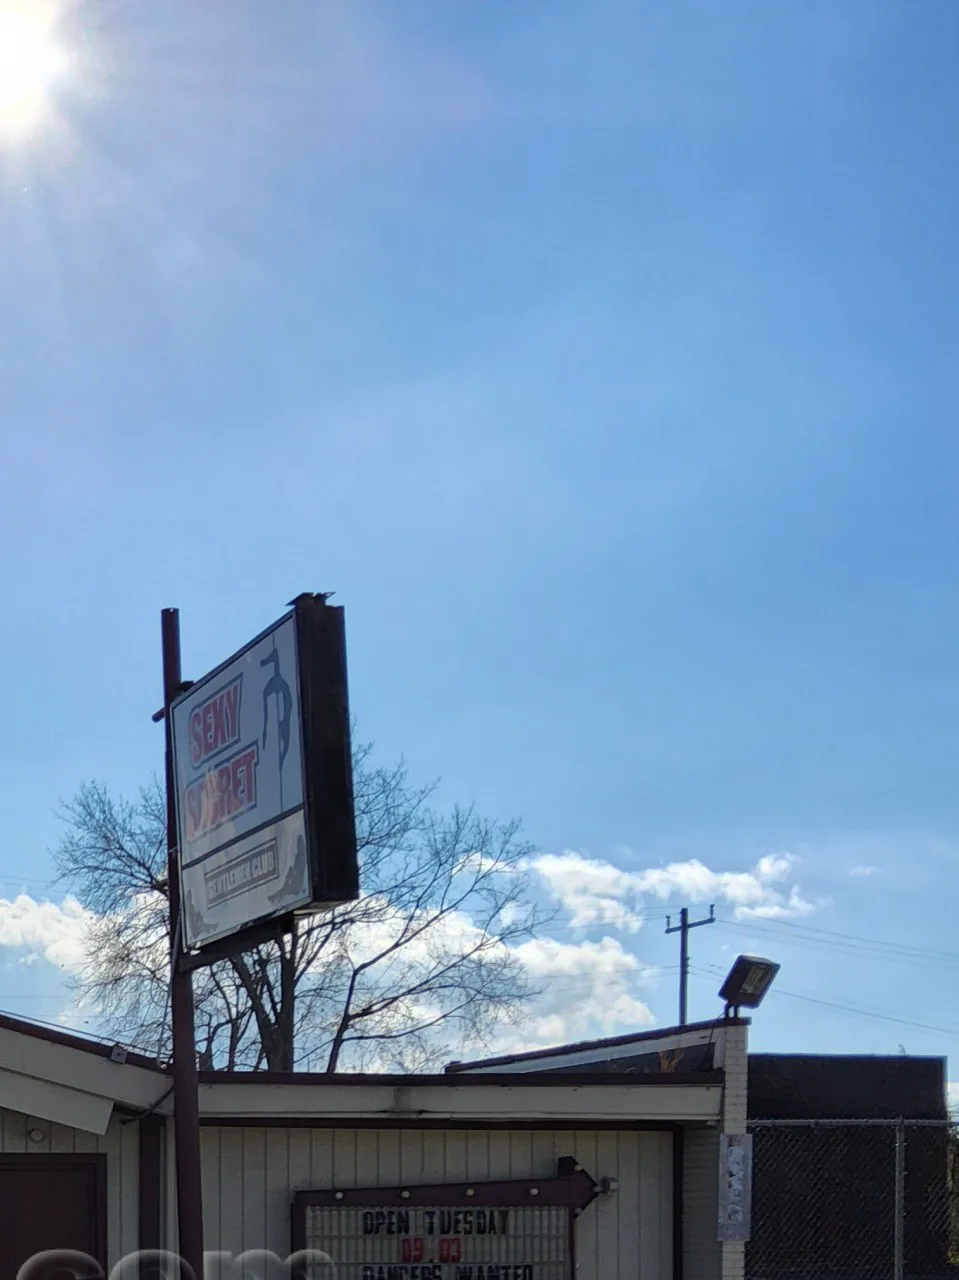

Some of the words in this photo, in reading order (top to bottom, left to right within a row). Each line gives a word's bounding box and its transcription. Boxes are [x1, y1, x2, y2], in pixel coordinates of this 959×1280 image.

[190, 684, 239, 765] SEXY
[252, 851, 275, 878] CLUB
[362, 1210, 410, 1235] OPEN
[425, 1209, 510, 1235] TUESDAY
